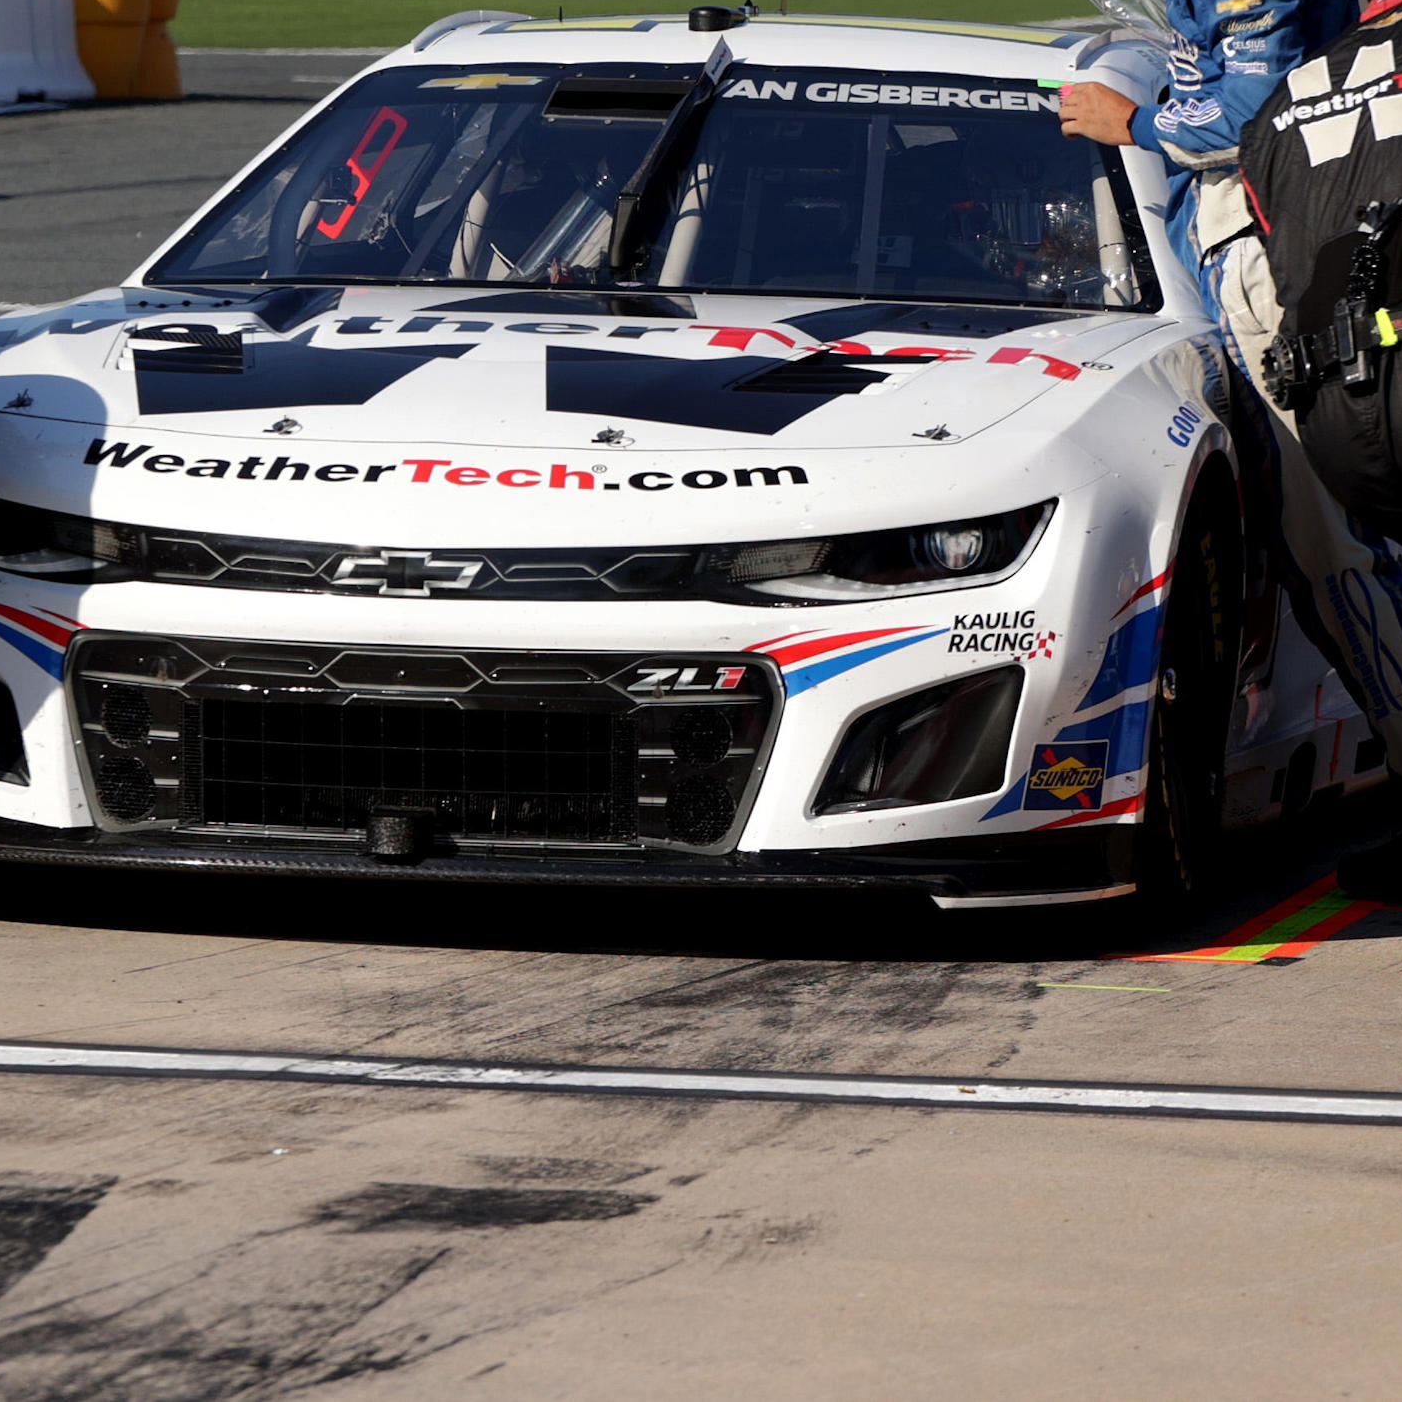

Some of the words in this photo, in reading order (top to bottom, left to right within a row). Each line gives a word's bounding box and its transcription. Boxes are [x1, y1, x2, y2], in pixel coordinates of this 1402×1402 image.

[805, 82, 1061, 114] GISBERGEN
[953, 610, 1035, 631] KAULIG
[948, 631, 1034, 655] RACING
[627, 666, 747, 693] ZL1
[1030, 767, 1103, 788] SUNOCO
